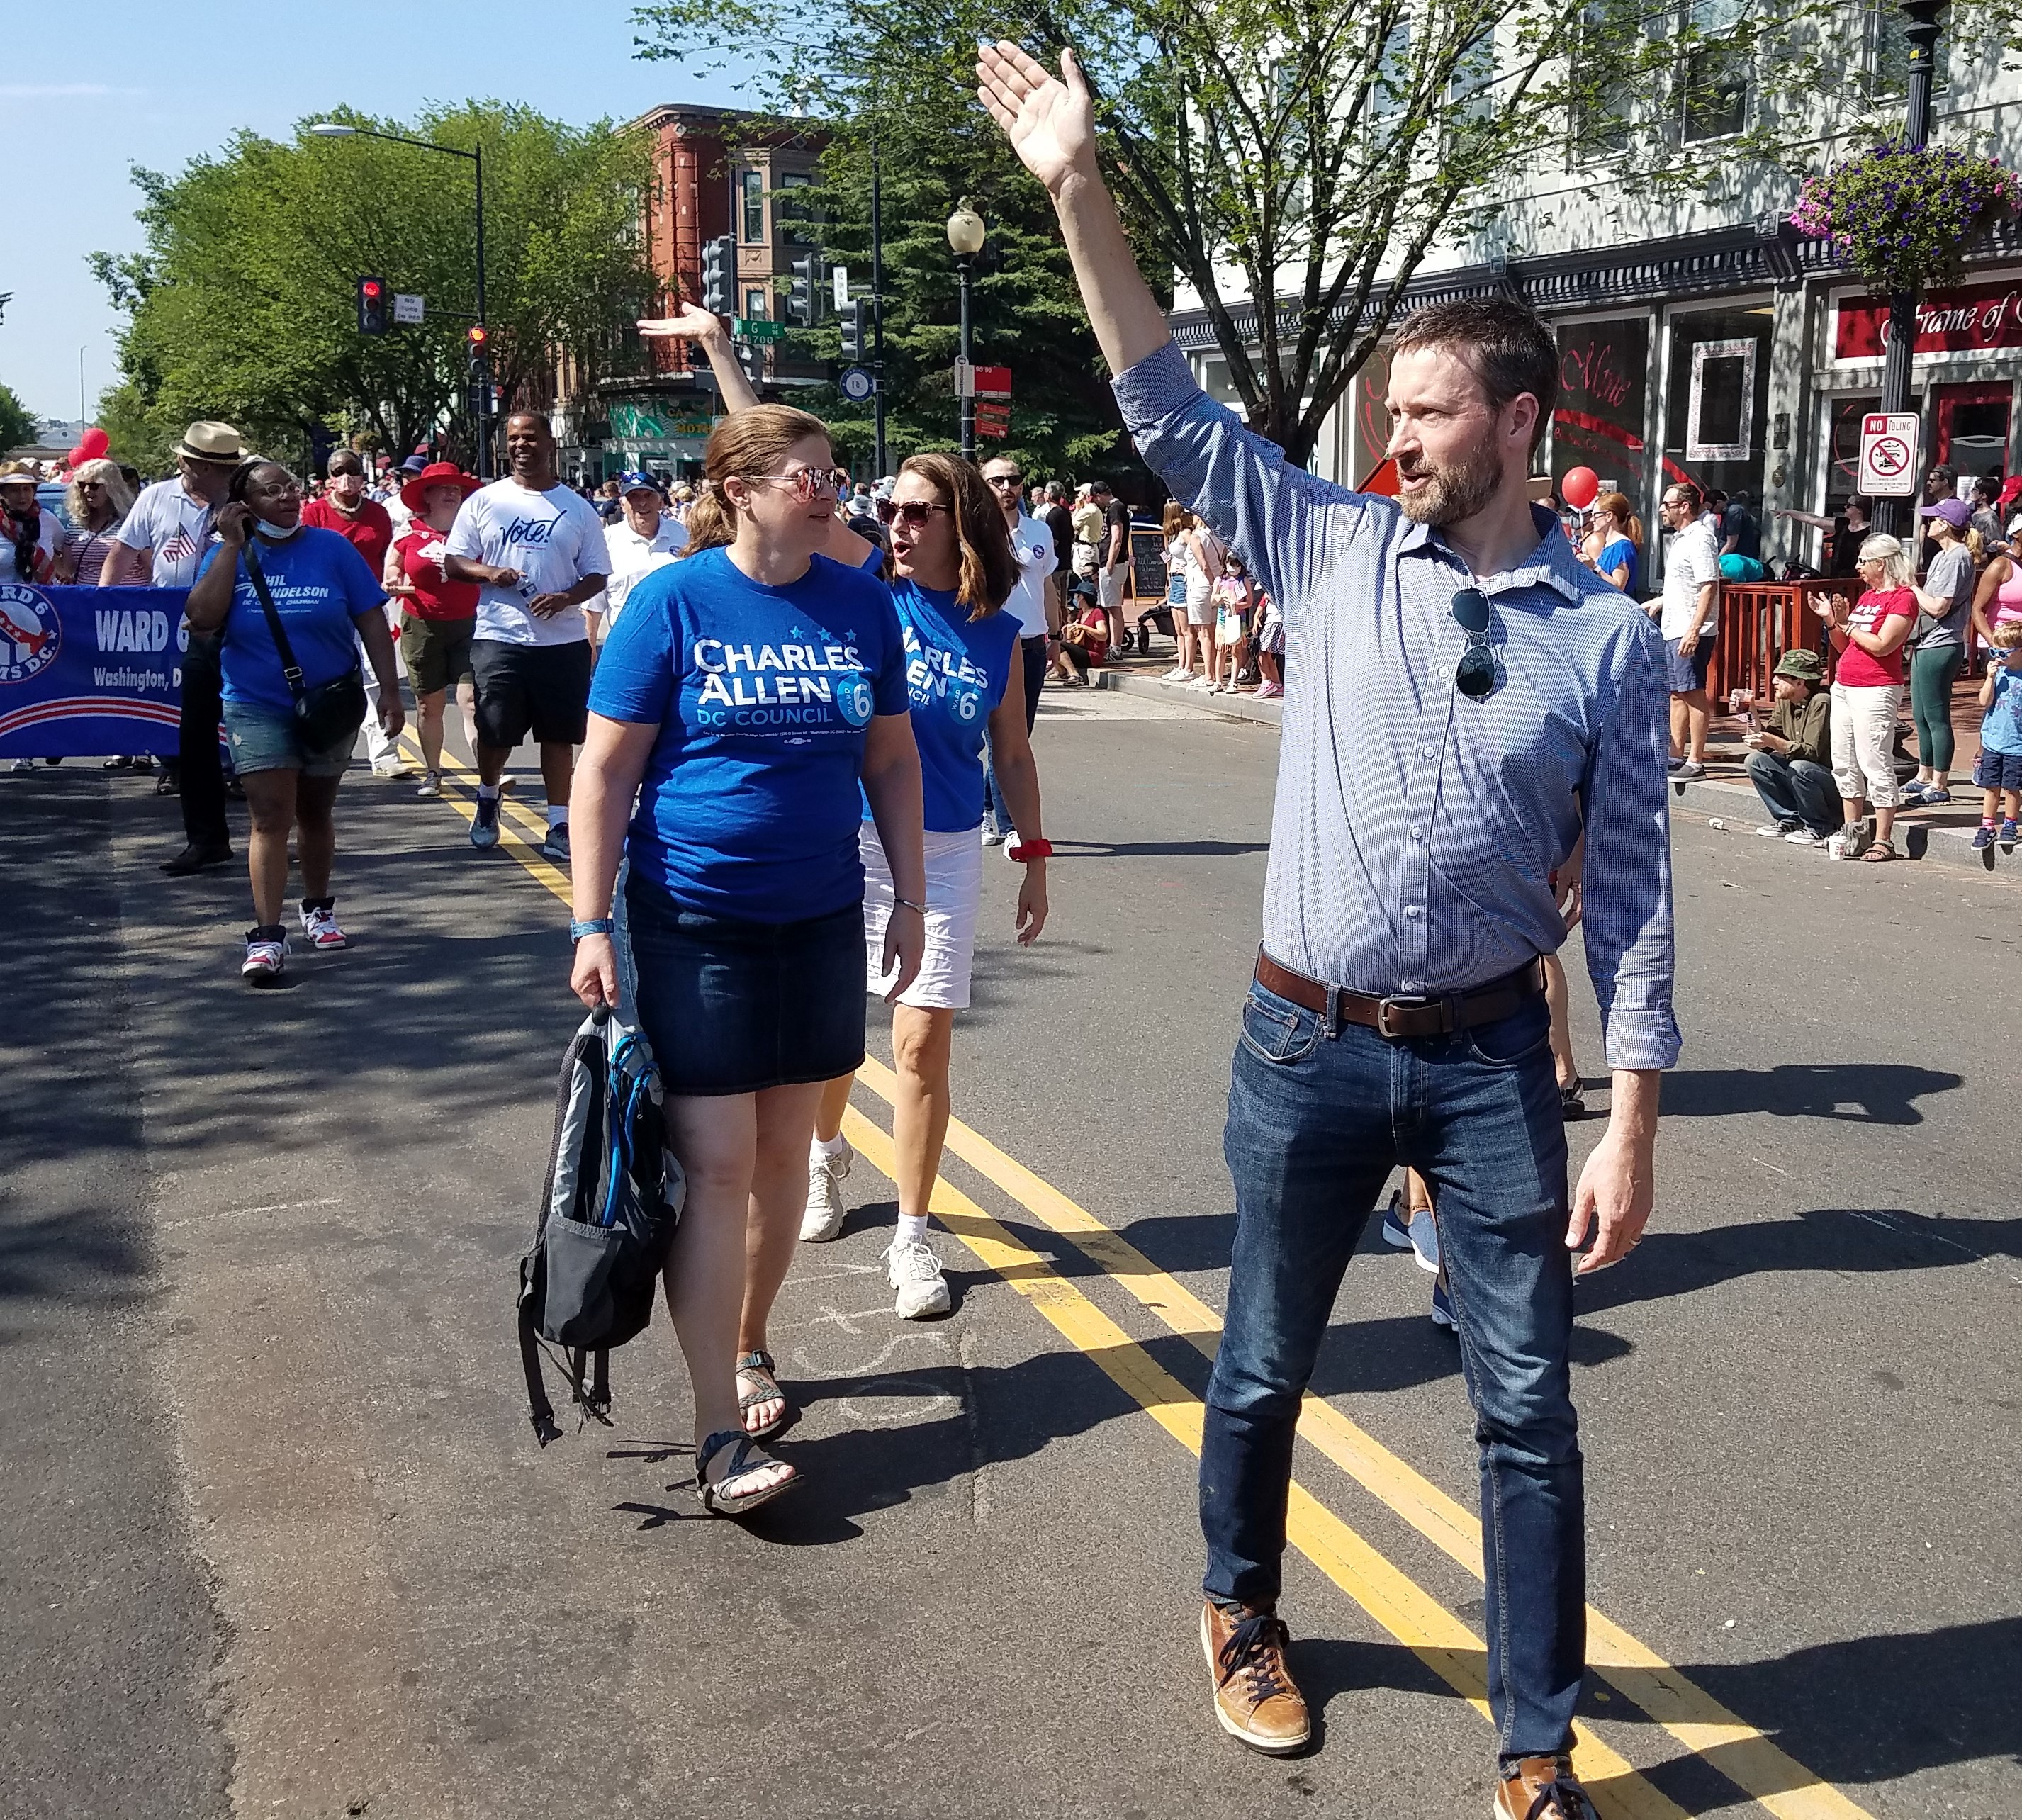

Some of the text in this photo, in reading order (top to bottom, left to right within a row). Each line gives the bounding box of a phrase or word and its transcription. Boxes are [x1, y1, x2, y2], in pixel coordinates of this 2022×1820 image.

[751, 322, 758, 334] G
[1982, 290, 2018, 342] of
[1870, 420, 1911, 432] NO IDLING
[500, 510, 568, 545] Vote!
[246, 586, 329, 598] MNDELSON
[263, 573, 286, 587] HIL
[35, 602, 49, 615] 6
[95, 610, 169, 652] WARD
[694, 639, 865, 673] CHARLES
[94, 666, 169, 692] Washington,
[697, 673, 833, 707] ALLEN
[853, 683, 870, 718] 6
[952, 689, 979, 720] WARD 6
[697, 707, 833, 726] DC COUNCIL
